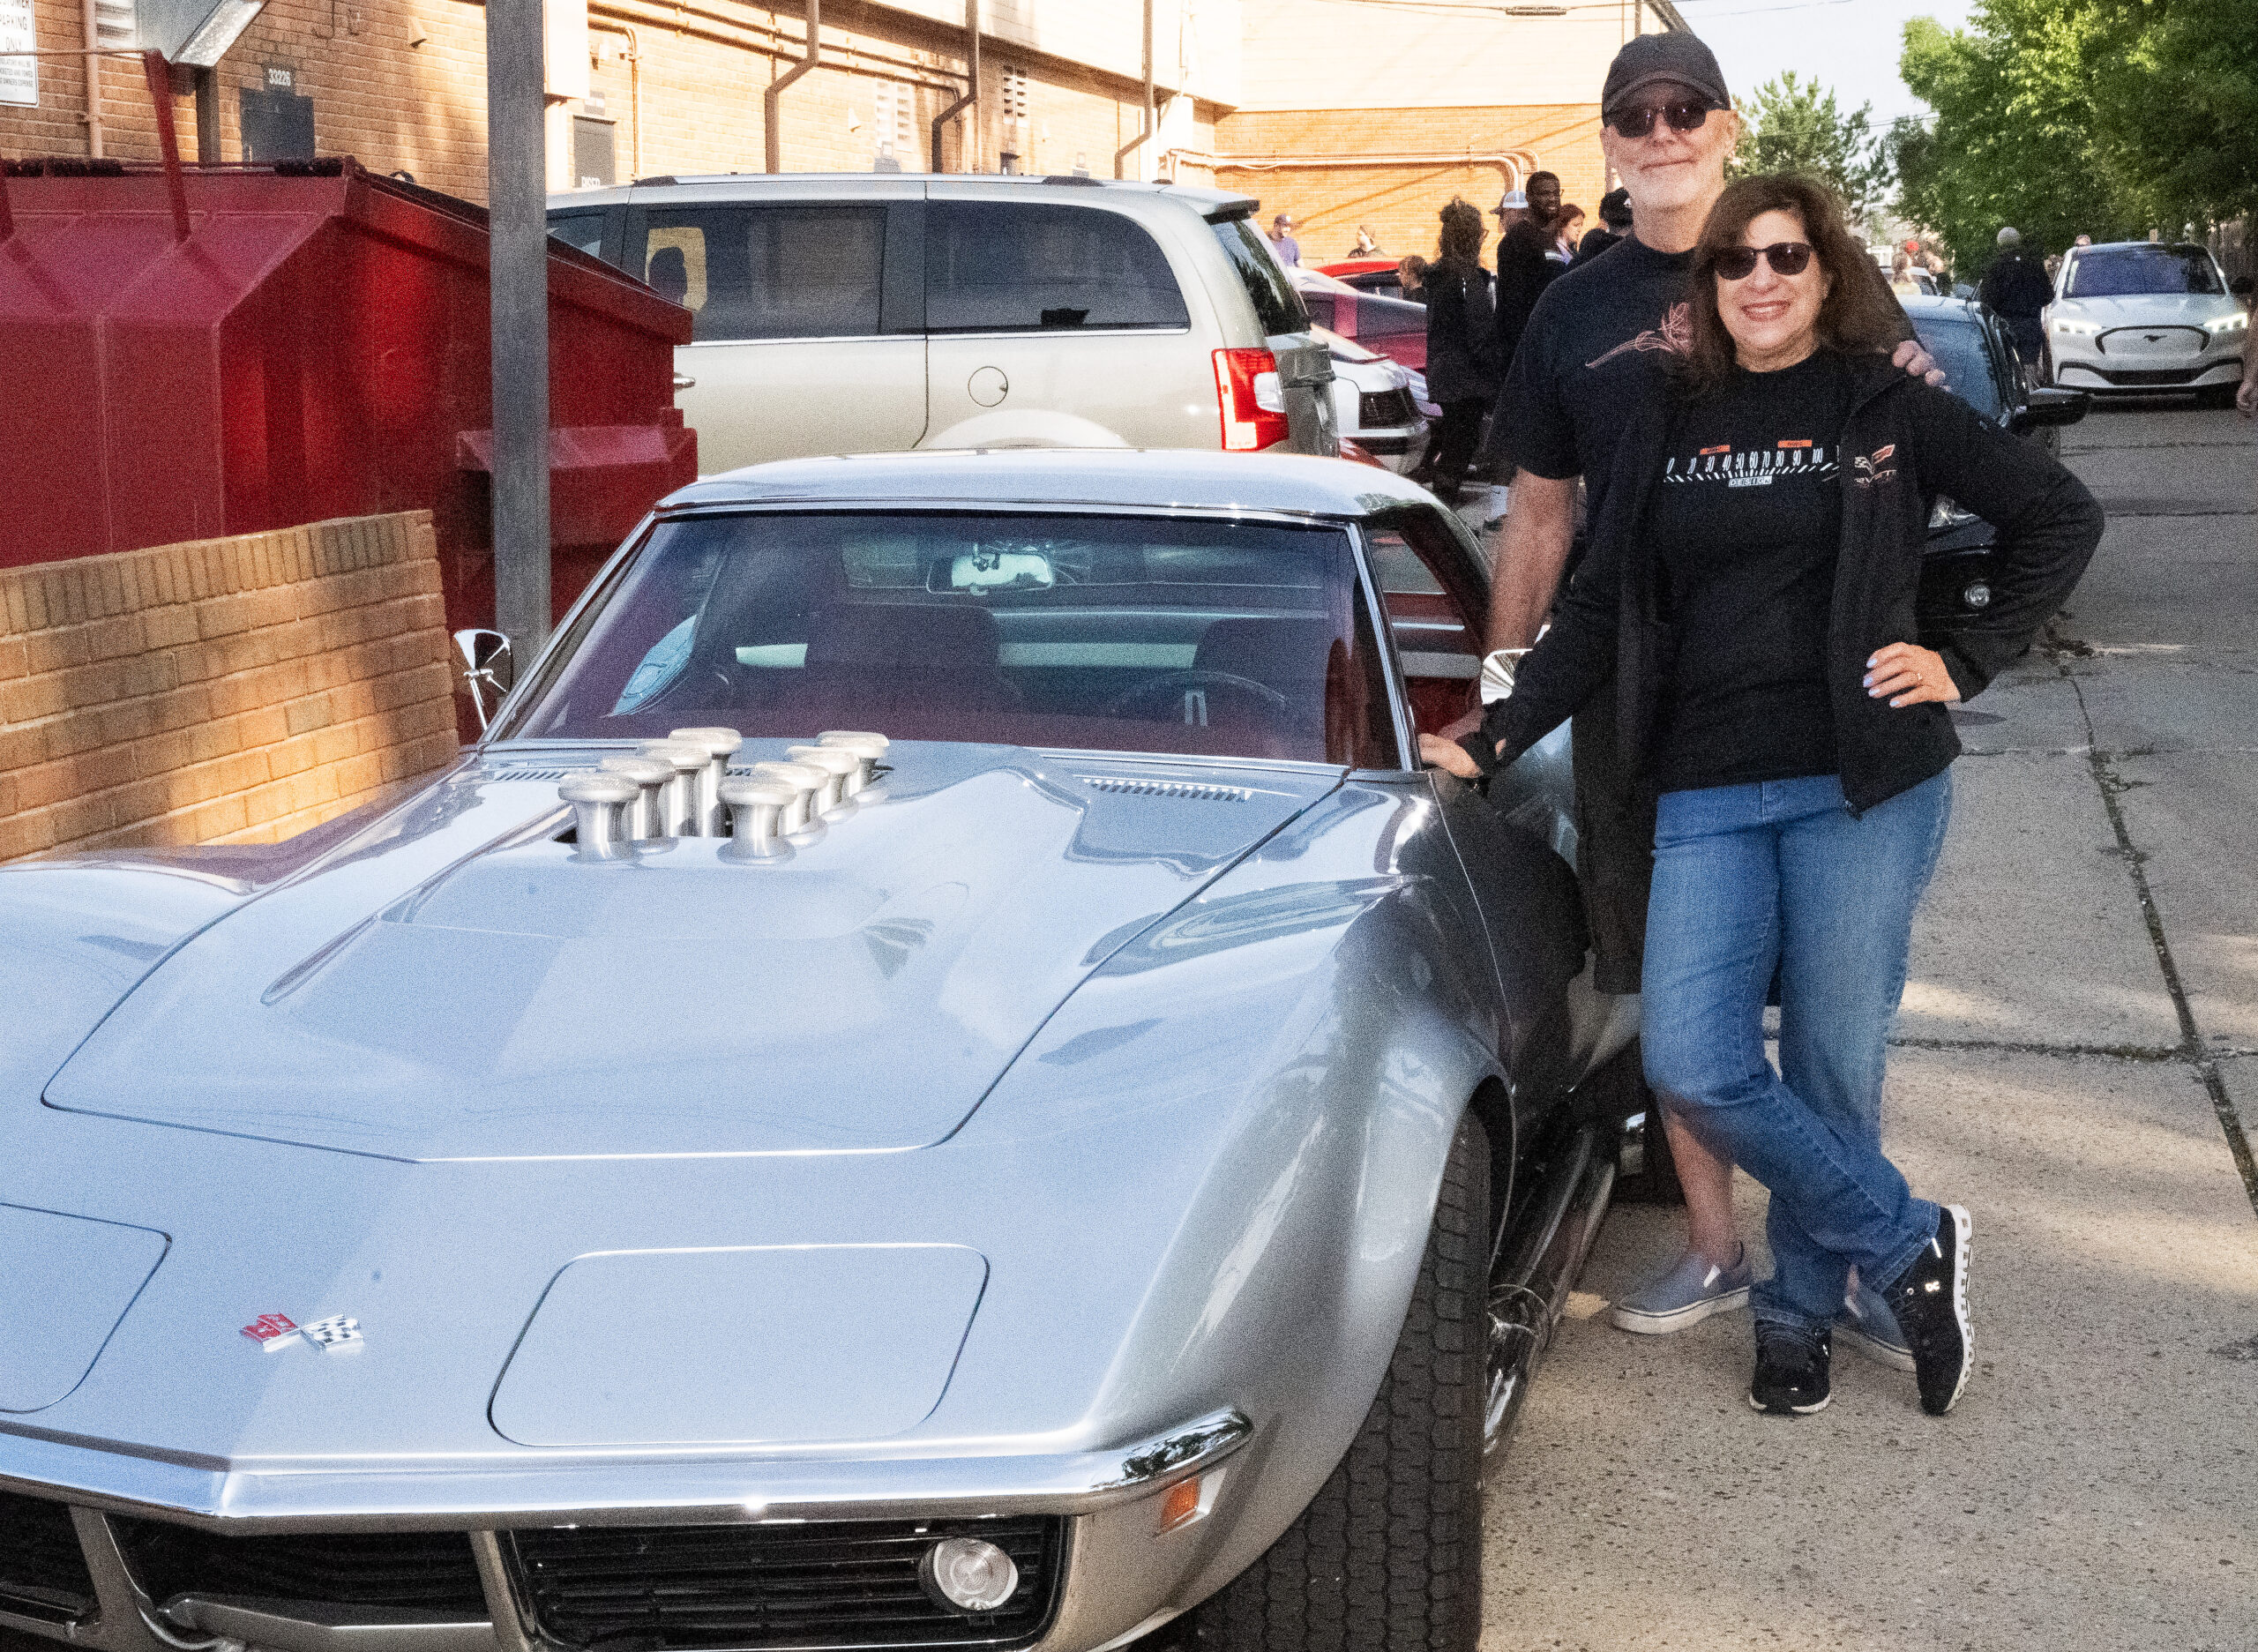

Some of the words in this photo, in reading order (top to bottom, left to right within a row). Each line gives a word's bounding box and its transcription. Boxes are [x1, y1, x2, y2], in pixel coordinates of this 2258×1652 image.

[1722, 454, 1732, 471] 40
[1735, 452, 1745, 470] 50
[1749, 451, 1759, 469] 60
[1762, 451, 1771, 468] 70
[1776, 450, 1785, 467] 80
[1792, 449, 1802, 467] 90
[1813, 447, 1823, 464] 100
[1730, 476, 1771, 486] DESIGN
